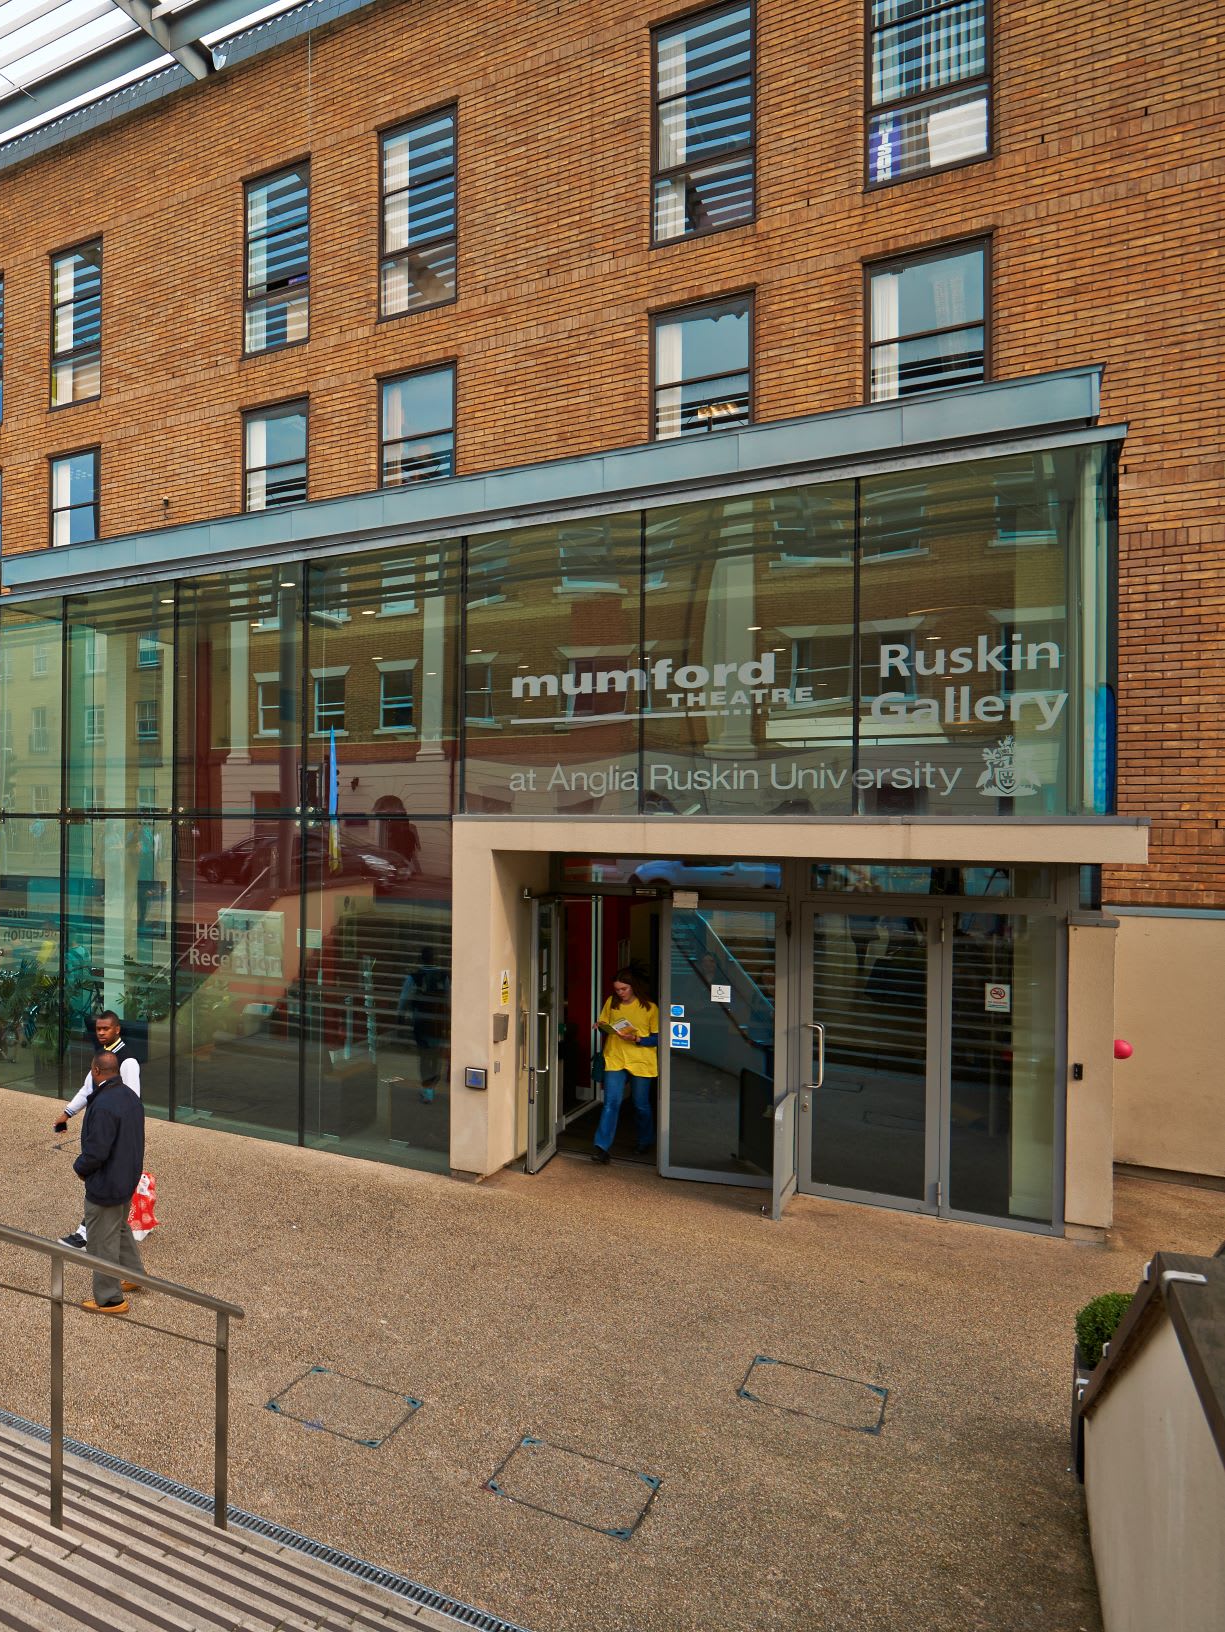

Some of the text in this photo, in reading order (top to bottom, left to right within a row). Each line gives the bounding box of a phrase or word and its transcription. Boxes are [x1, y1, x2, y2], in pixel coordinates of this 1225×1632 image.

[511, 652, 776, 698] mumford
[880, 633, 1060, 678] Ruskin
[666, 686, 814, 708] THEATRE
[871, 685, 1069, 731] Gallery
[509, 760, 963, 798] at Anglia Ruskin University
[189, 947, 283, 976] Reception
